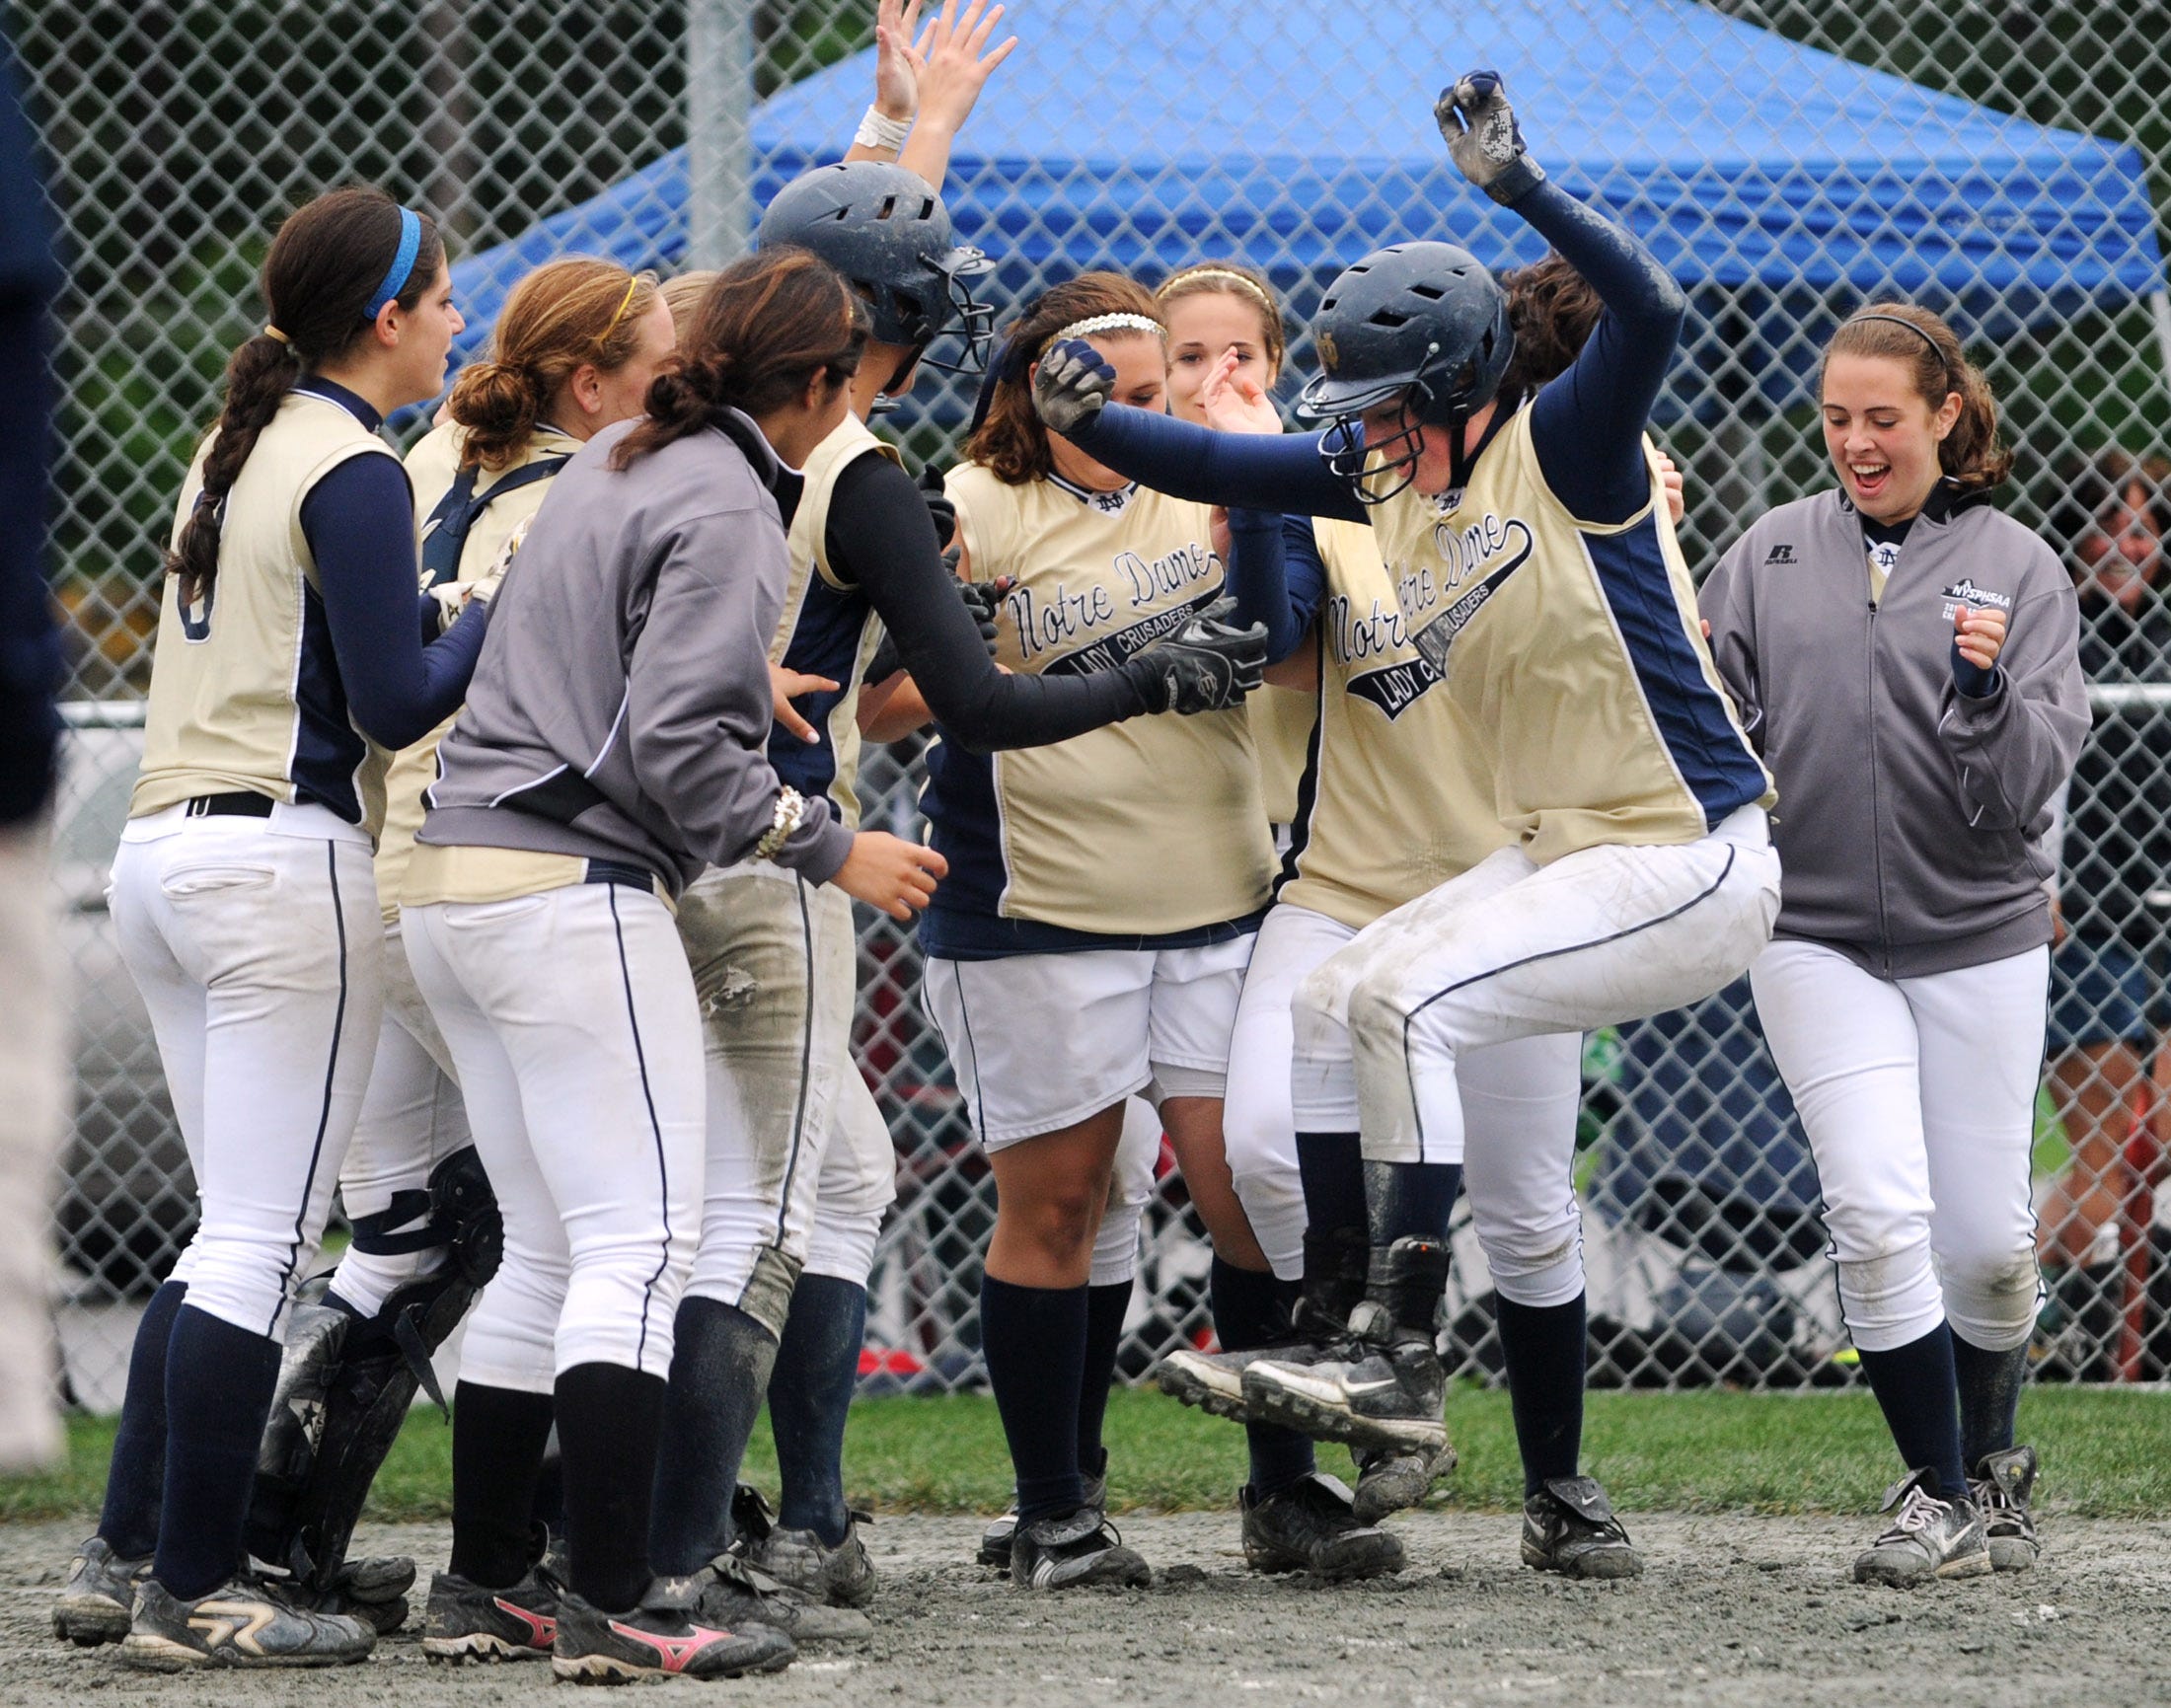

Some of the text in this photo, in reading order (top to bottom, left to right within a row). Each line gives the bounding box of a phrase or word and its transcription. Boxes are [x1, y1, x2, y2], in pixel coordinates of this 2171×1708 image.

[1007, 543, 1211, 660] Notre Dame
[1952, 579, 2011, 608] NYSPHSAA
[1116, 604, 1194, 653] CRUSADERS
[1330, 594, 1414, 666] Notr
[1372, 665, 1420, 710] LADY
